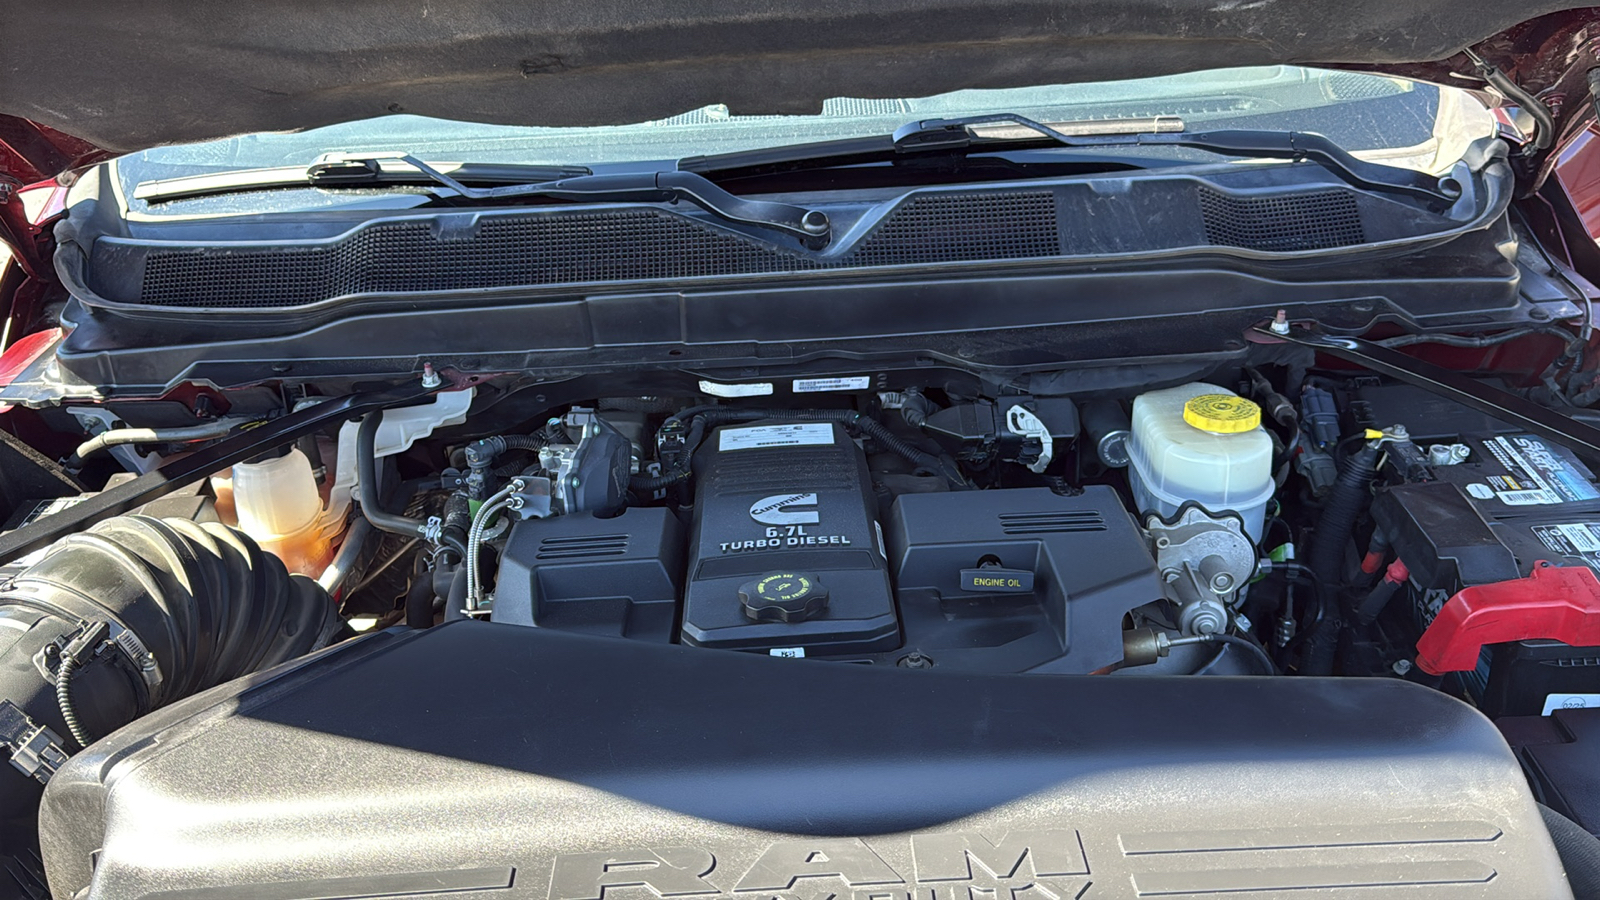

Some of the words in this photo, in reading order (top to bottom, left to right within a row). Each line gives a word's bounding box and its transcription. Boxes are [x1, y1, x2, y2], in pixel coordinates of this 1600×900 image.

[751, 493, 811, 515] Cummins
[765, 525, 807, 538] 6.7L
[720, 538, 780, 551] TURBO
[787, 535, 851, 545] DIESEL
[974, 578, 1005, 587] ENGINE
[1008, 579, 1021, 587] OIL
[547, 829, 1091, 900] RAM
